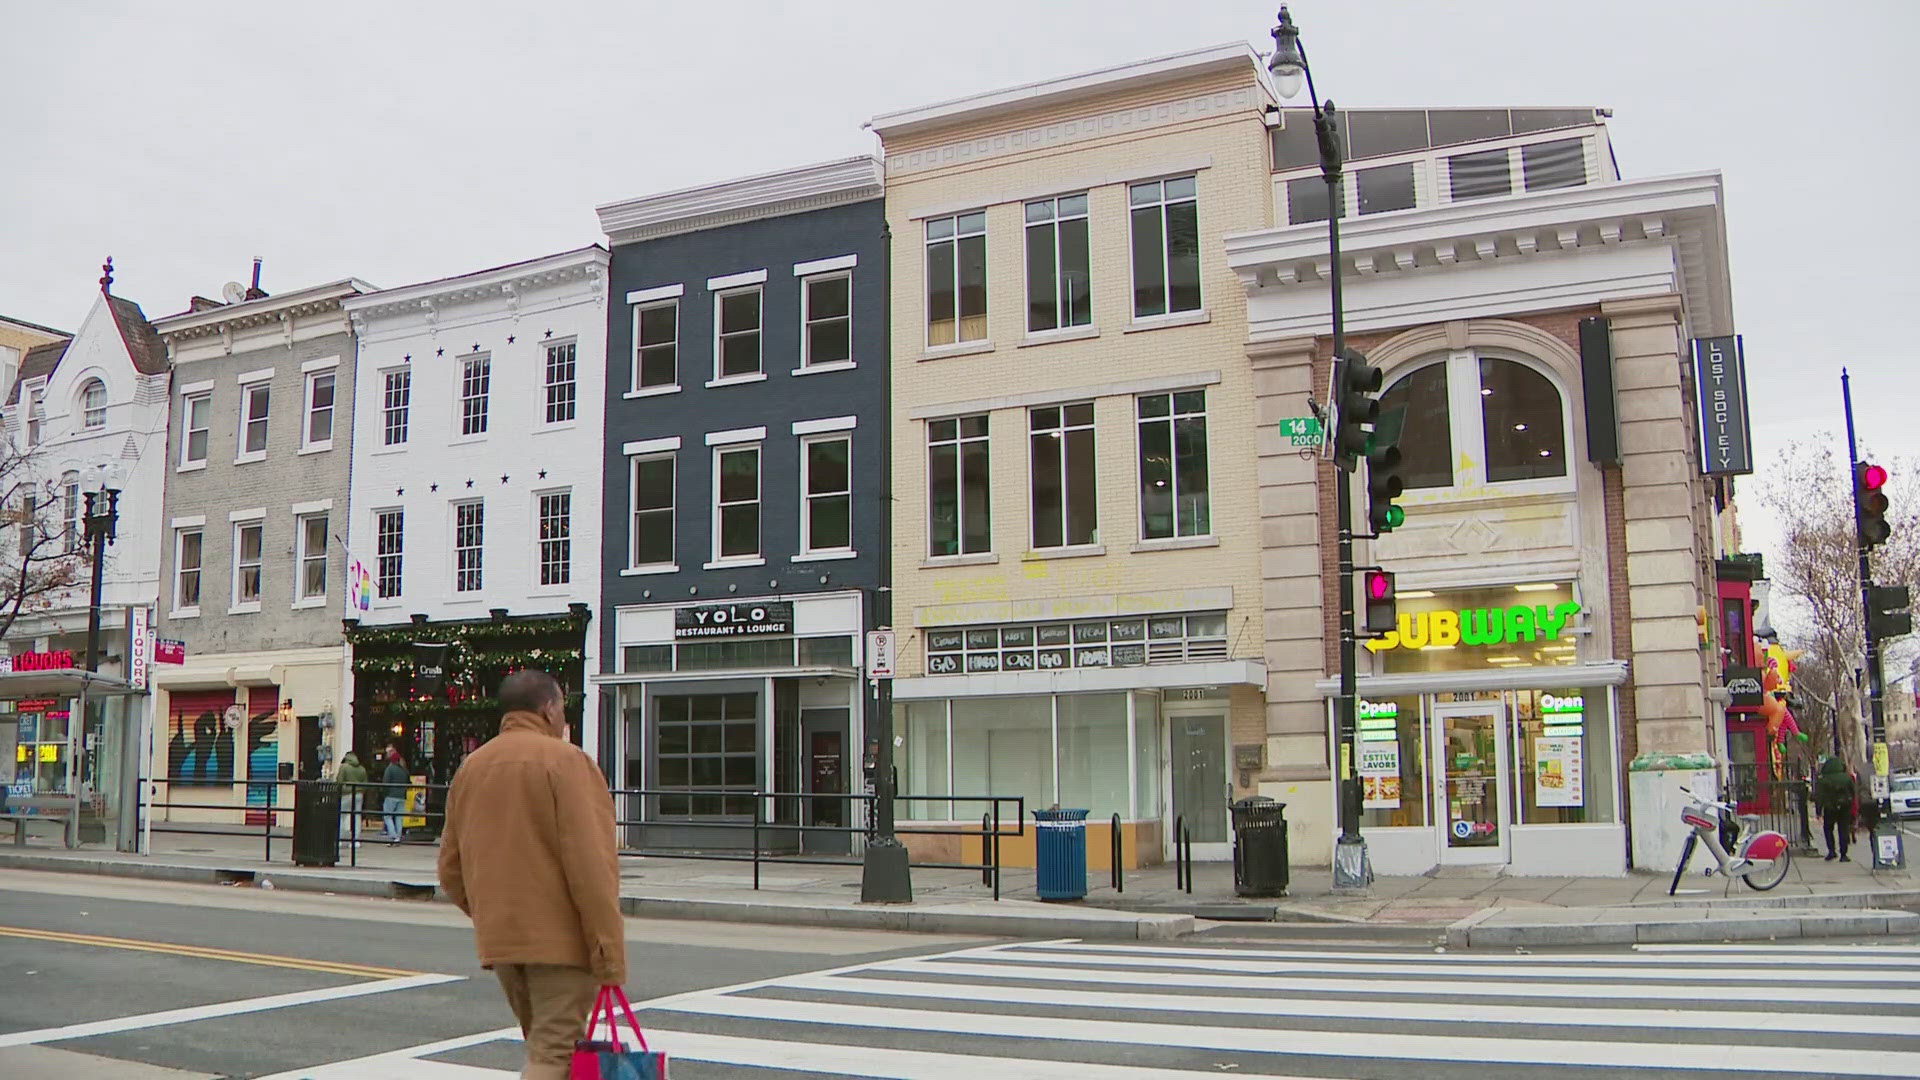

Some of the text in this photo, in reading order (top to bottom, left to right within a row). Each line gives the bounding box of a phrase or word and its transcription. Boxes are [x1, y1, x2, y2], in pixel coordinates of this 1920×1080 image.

[1710, 342, 1730, 469] LOST SOCIETY
[1289, 420, 1307, 433] 14
[1293, 435, 1321, 445] 2000
[695, 605, 765, 624] YOLO
[676, 624, 785, 636] RESTAURANT & LOUNGE
[134, 617, 144, 687] LIQUORS
[12, 650, 73, 672] LIQUORS
[1183, 689, 1204, 700] 2001
[1453, 692, 1475, 702] 2001
[1359, 700, 1397, 718] Open
[1540, 694, 1583, 712] Open
[1362, 753, 1396, 761] ESTIVE
[1362, 761, 1396, 769] LAVORS
